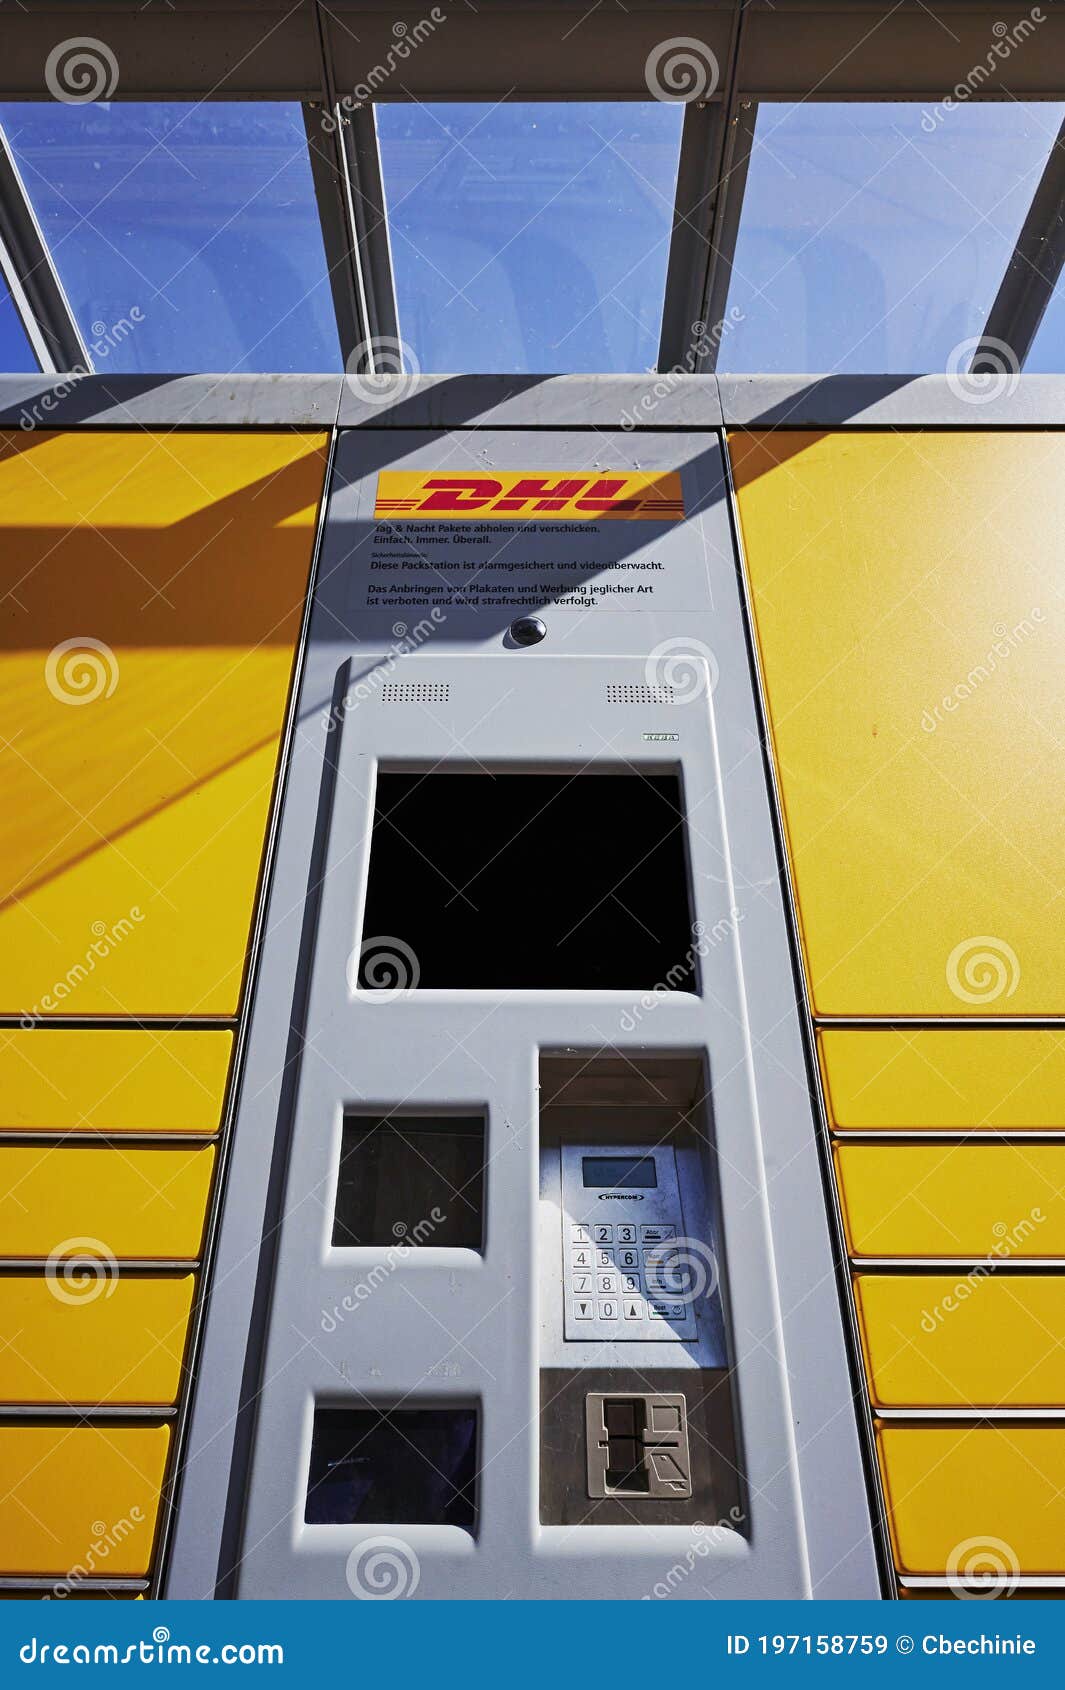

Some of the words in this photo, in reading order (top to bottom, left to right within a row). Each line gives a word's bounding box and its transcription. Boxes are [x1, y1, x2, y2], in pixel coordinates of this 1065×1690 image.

[416, 479, 639, 511] DHL
[375, 525, 392, 535] Tag
[395, 524, 402, 533] &
[406, 524, 435, 533] Nacht
[438, 524, 472, 533] Pakete
[474, 524, 515, 533] abholen
[517, 524, 537, 533] und
[540, 524, 600, 533] verschicken.
[373, 535, 413, 544] Einfach.
[416, 535, 450, 544] Immer.
[452, 534, 491, 544] Überall.
[370, 561, 399, 570] Diese
[401, 561, 460, 570] Packstation
[463, 561, 475, 570] ist
[478, 561, 554, 571] alarmgesichert
[557, 561, 577, 570] und
[580, 561, 665, 570] videoüberwacht.
[367, 584, 387, 593] Das
[388, 584, 444, 595] Anbringen
[469, 584, 514, 593] Plakaten
[517, 584, 538, 593] und
[540, 584, 587, 595] Werbung
[589, 584, 634, 595] jeglicher
[636, 584, 653, 593] Art
[366, 596, 379, 605] ist
[382, 596, 430, 605] verboten
[432, 596, 453, 605] und
[455, 596, 479, 605] wird
[481, 596, 551, 605] strafrechtlich
[553, 596, 598, 607] verfolgt.
[576, 1229, 584, 1240] 1
[599, 1229, 608, 1240] 2
[622, 1229, 631, 1240] 3
[577, 1252, 586, 1264] 4
[601, 1252, 609, 1264] 5
[624, 1252, 633, 1264] 6
[578, 1277, 587, 1289] 7
[602, 1277, 611, 1289] 8
[626, 1277, 635, 1289] 9
[603, 1303, 613, 1316] 0
